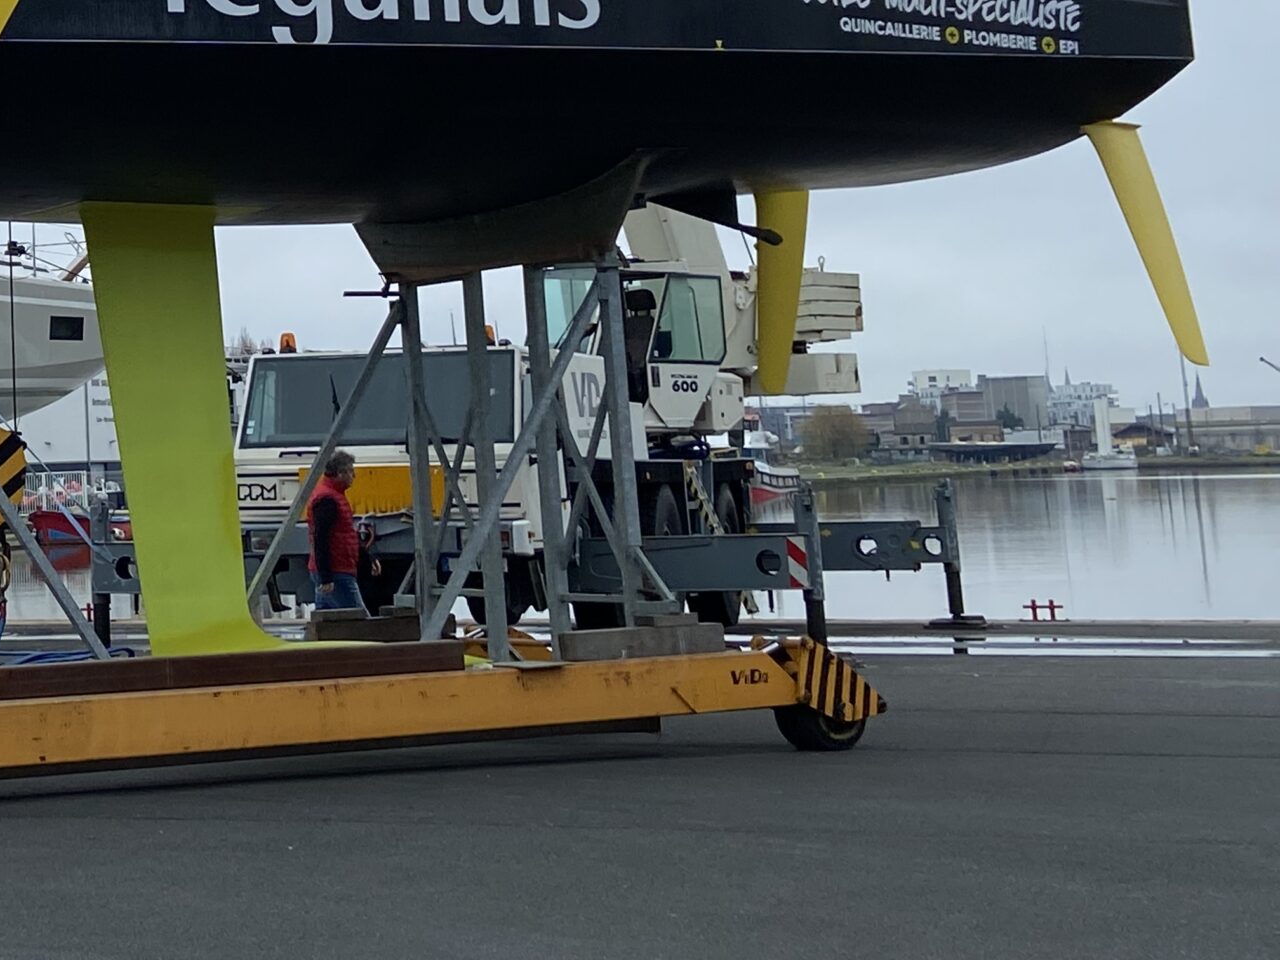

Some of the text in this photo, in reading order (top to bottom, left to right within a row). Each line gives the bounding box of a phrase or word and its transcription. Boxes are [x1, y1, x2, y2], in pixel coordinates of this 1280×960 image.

[839, 16, 1080, 55] QUINCAILLERIE PLOMBERIE EPI
[671, 380, 699, 393] 600
[237, 483, 277, 501] PPM
